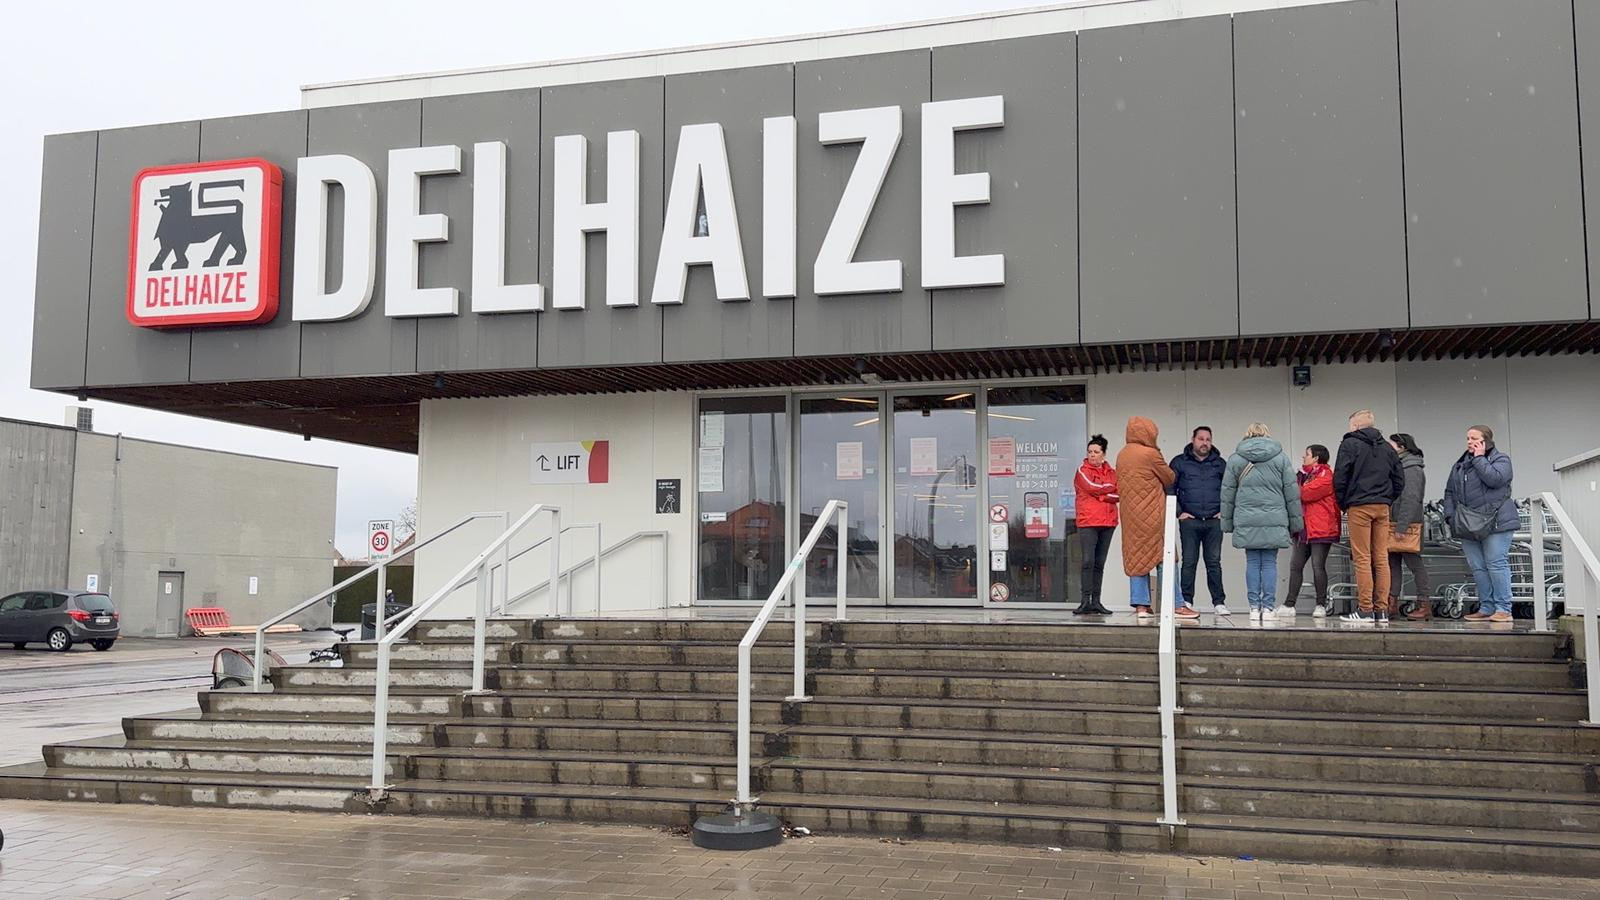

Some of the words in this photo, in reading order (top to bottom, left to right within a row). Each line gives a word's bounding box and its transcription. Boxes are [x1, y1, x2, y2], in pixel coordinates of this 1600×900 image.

[291, 94, 1005, 322] DELHAIZE
[146, 272, 247, 308] DELHAIZE
[1016, 442, 1058, 453] WELKOM
[557, 455, 580, 470] LIFT
[375, 537, 386, 546] 30
